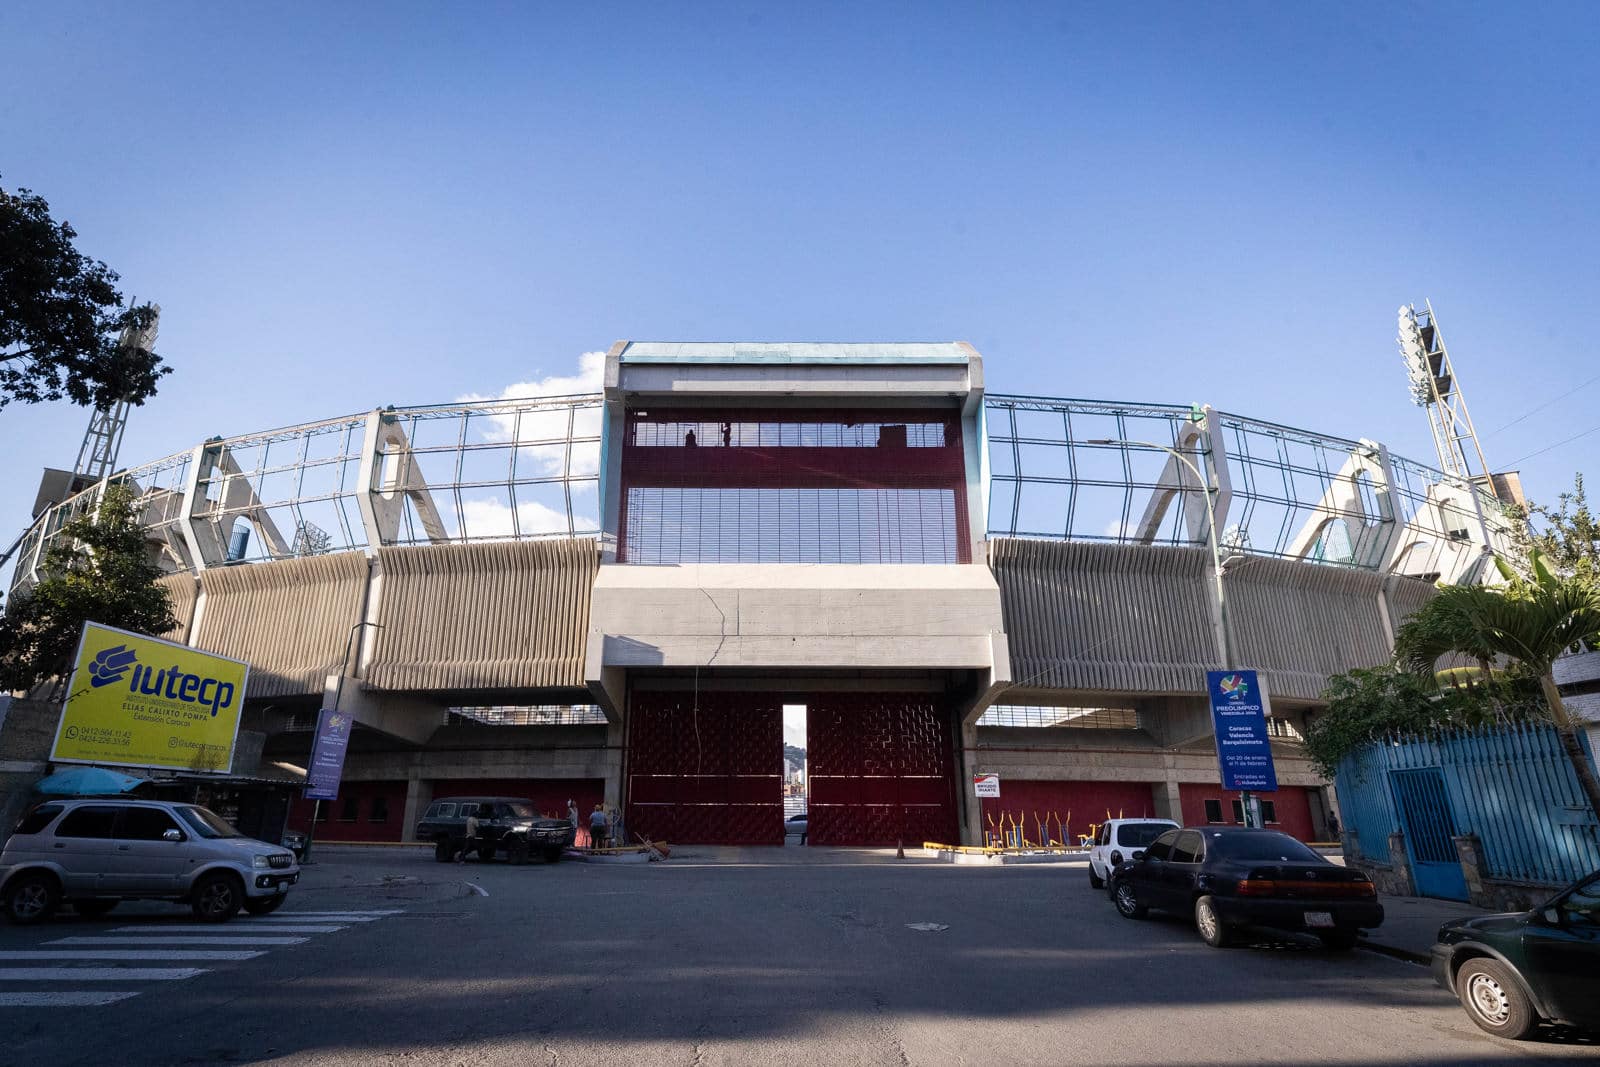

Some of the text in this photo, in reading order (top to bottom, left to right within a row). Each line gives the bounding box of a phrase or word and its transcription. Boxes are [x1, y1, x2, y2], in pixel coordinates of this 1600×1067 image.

[122, 703, 208, 721] ELIAS CALIXTO POMPA
